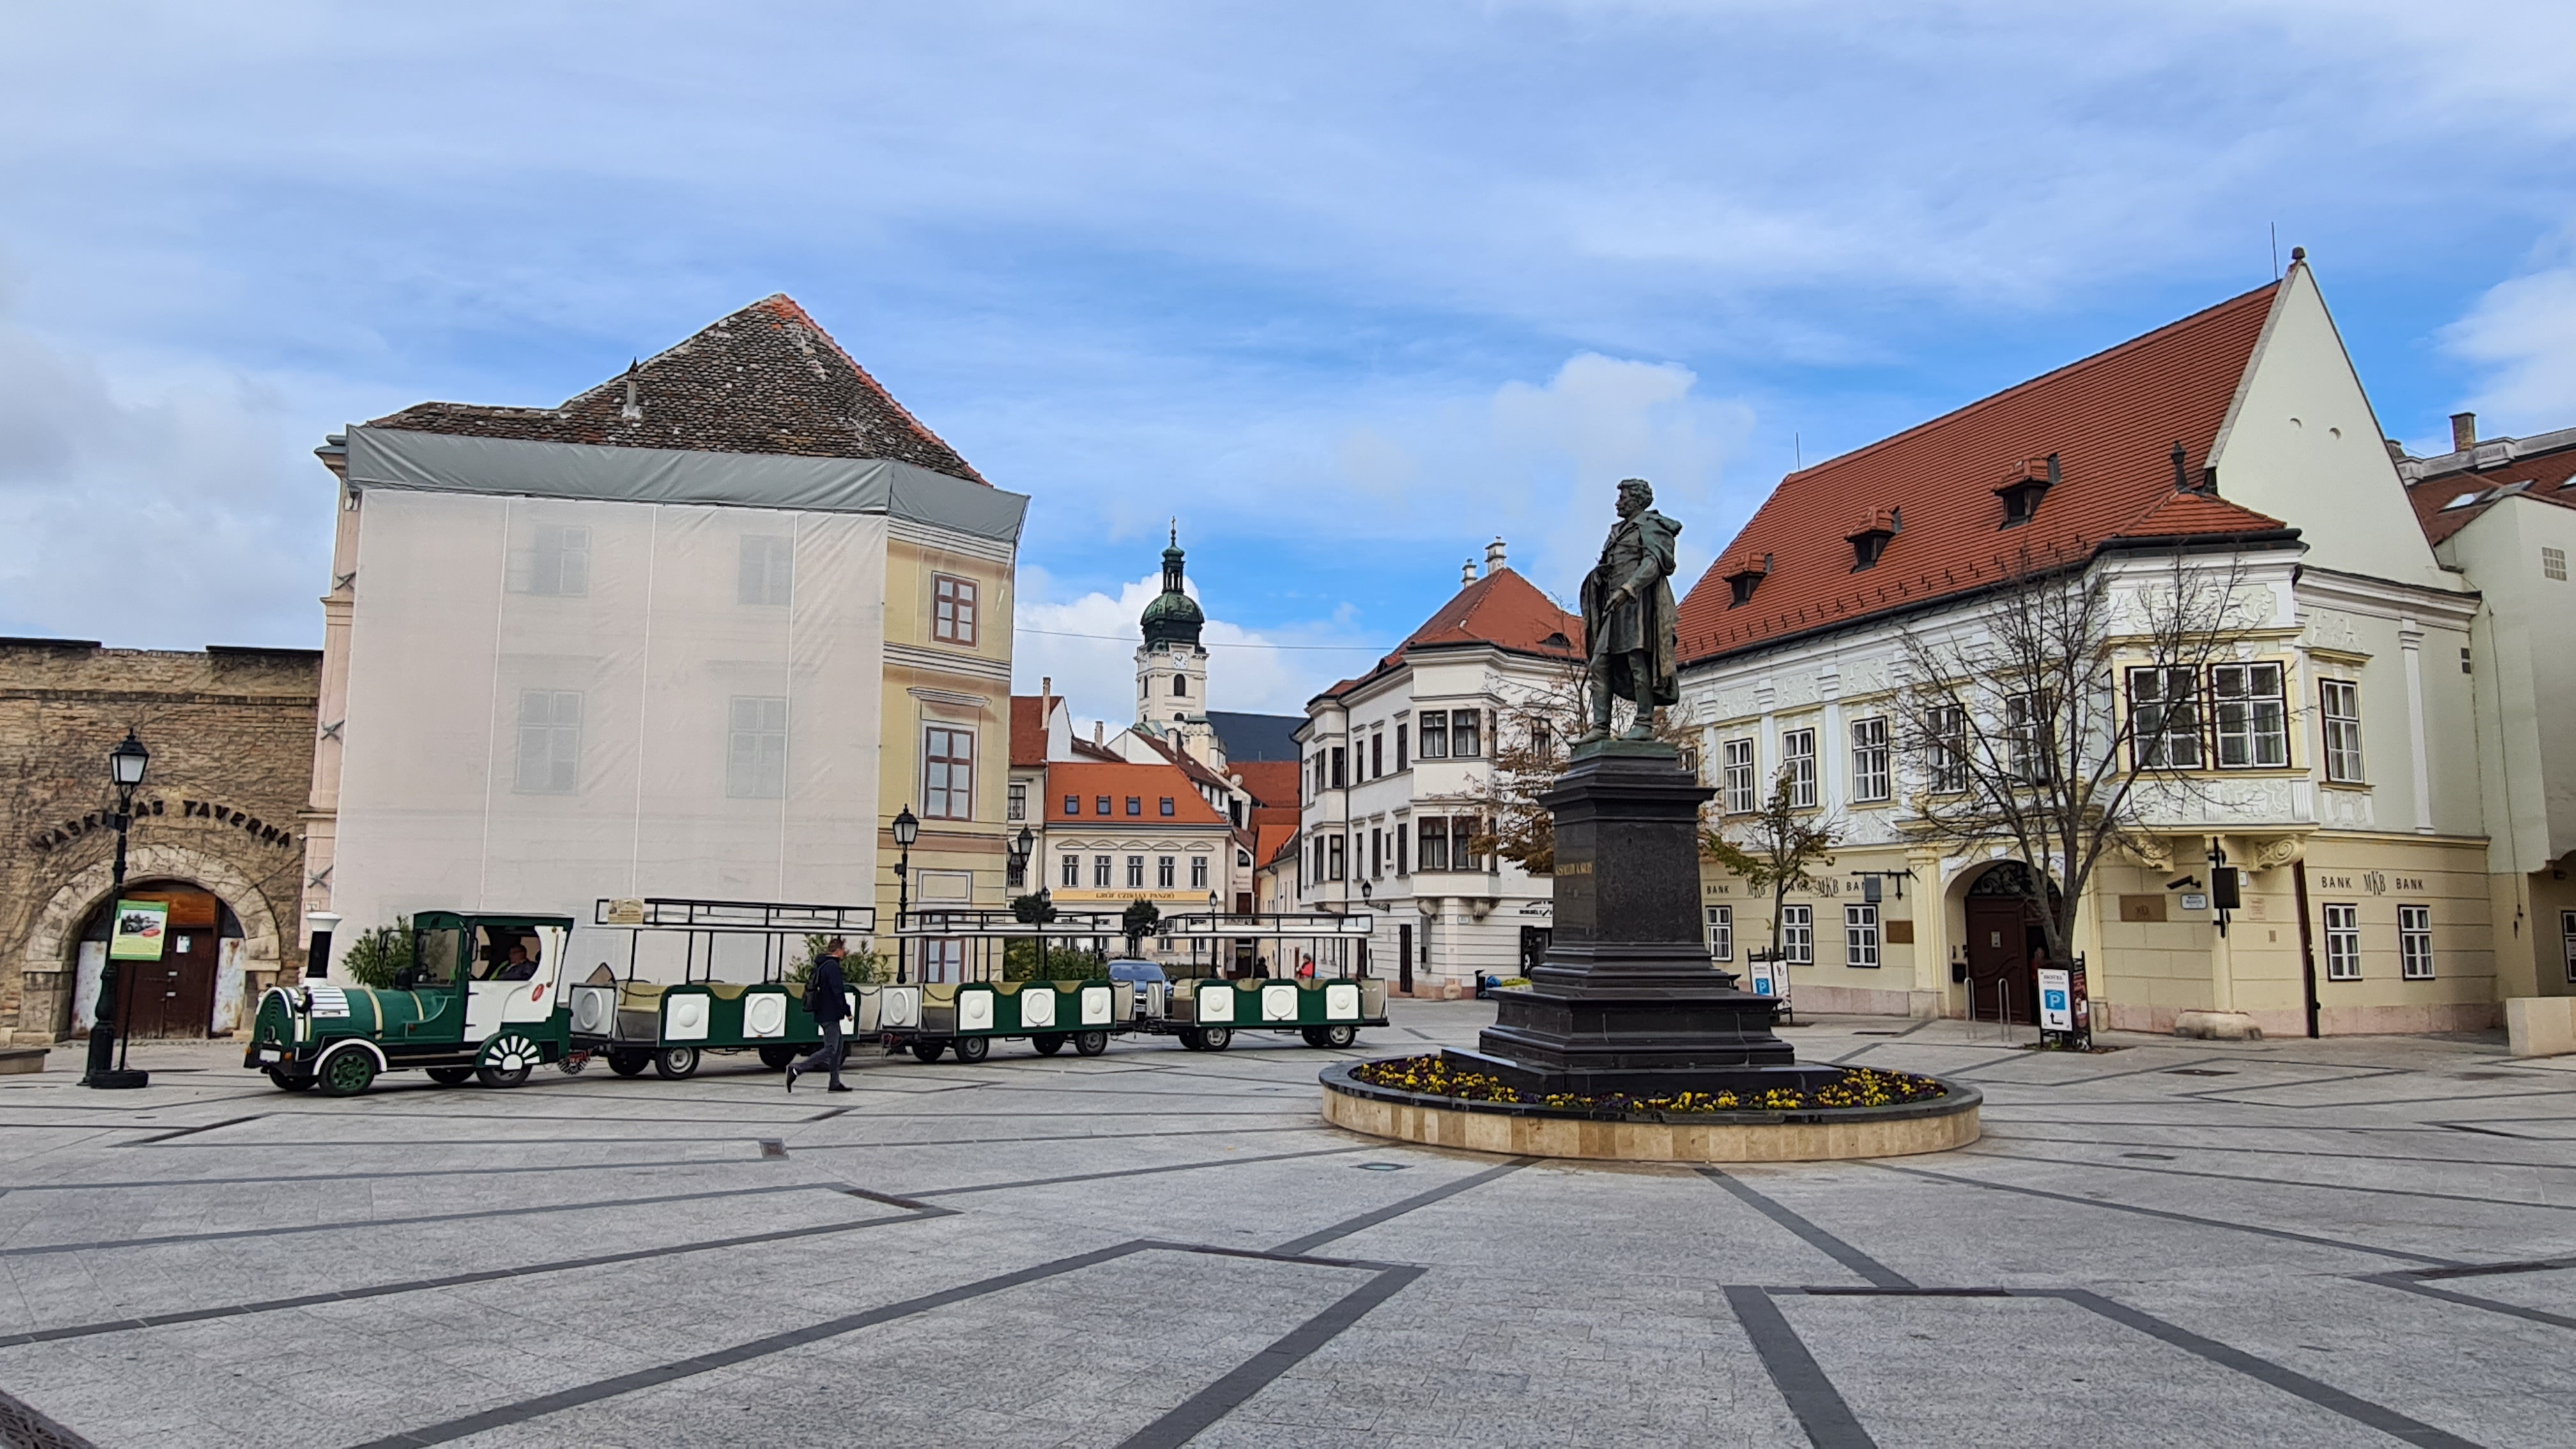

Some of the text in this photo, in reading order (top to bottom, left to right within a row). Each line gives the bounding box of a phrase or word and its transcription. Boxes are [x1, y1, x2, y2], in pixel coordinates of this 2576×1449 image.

[34, 800, 291, 852] VASKAS TAVERNA
[1706, 885, 1729, 894] BANK
[1846, 882, 1866, 891] BAN
[2321, 871, 2424, 896] BANK MKB BANK
[2050, 994, 2061, 1008] P
